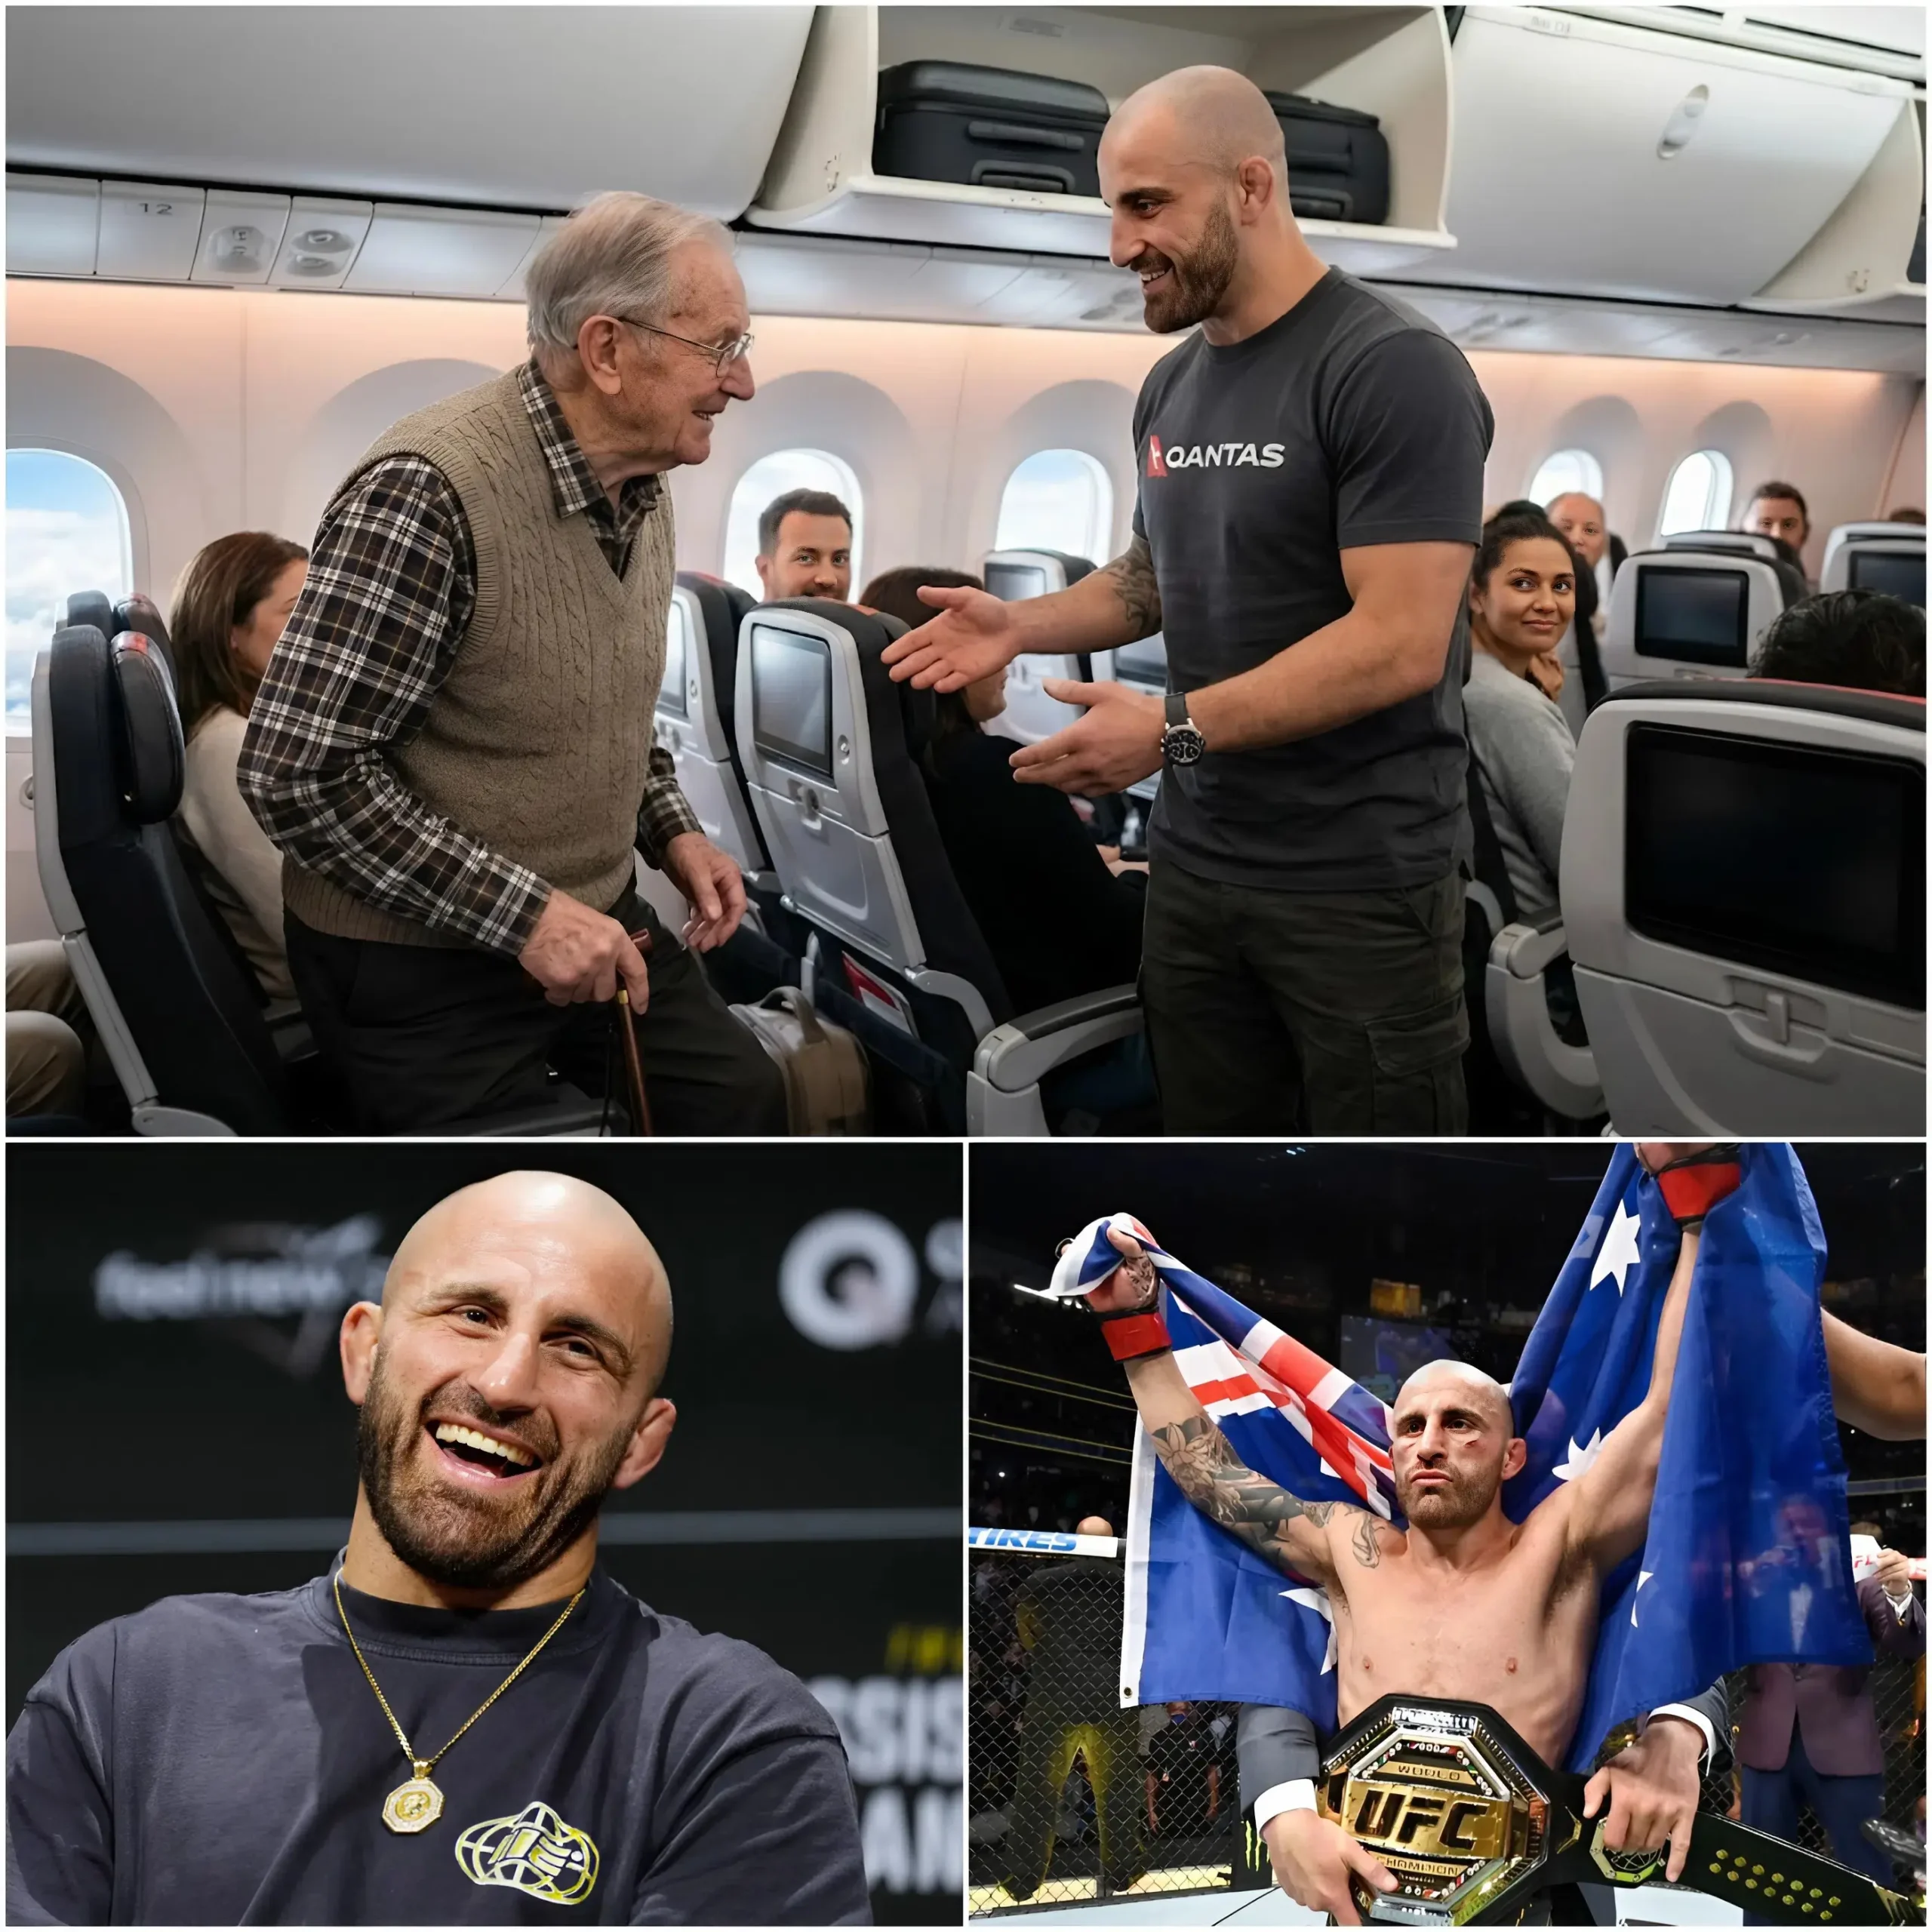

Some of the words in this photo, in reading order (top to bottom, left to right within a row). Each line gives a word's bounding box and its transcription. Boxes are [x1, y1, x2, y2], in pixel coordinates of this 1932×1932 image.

[139, 203, 172, 215] 12
[1165, 444, 1285, 469] QANTAS
[969, 1527, 1078, 1552] TIRES
[1354, 1788, 1490, 1849] UFC
